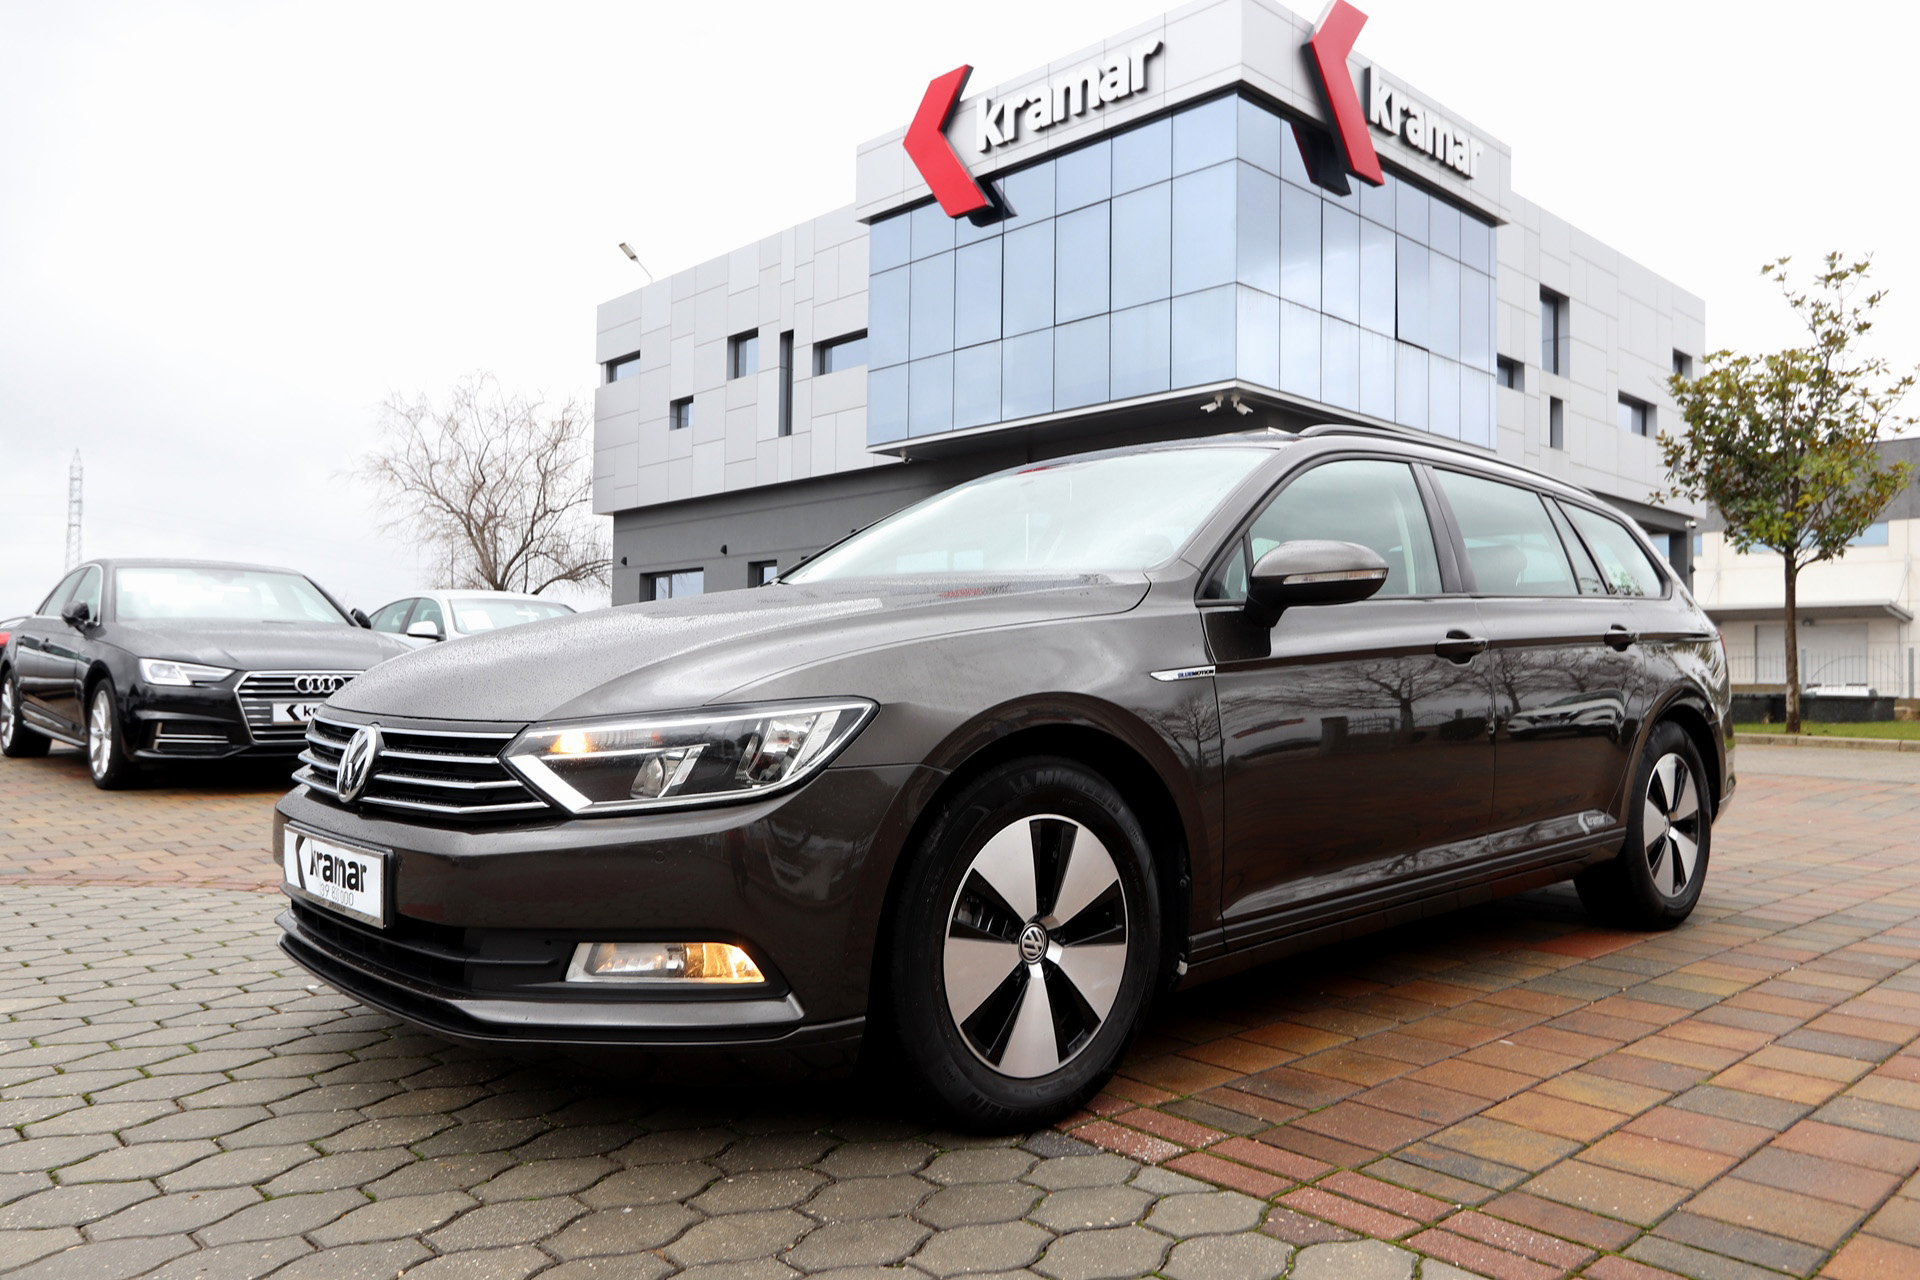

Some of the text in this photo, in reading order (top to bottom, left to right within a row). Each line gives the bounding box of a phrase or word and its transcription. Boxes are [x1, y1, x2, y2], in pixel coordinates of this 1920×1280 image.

[976, 37, 1163, 153] kramar
[1366, 65, 1484, 180] kramar
[1034, 770, 1124, 814] MICHELIN
[309, 839, 367, 893] kramar
